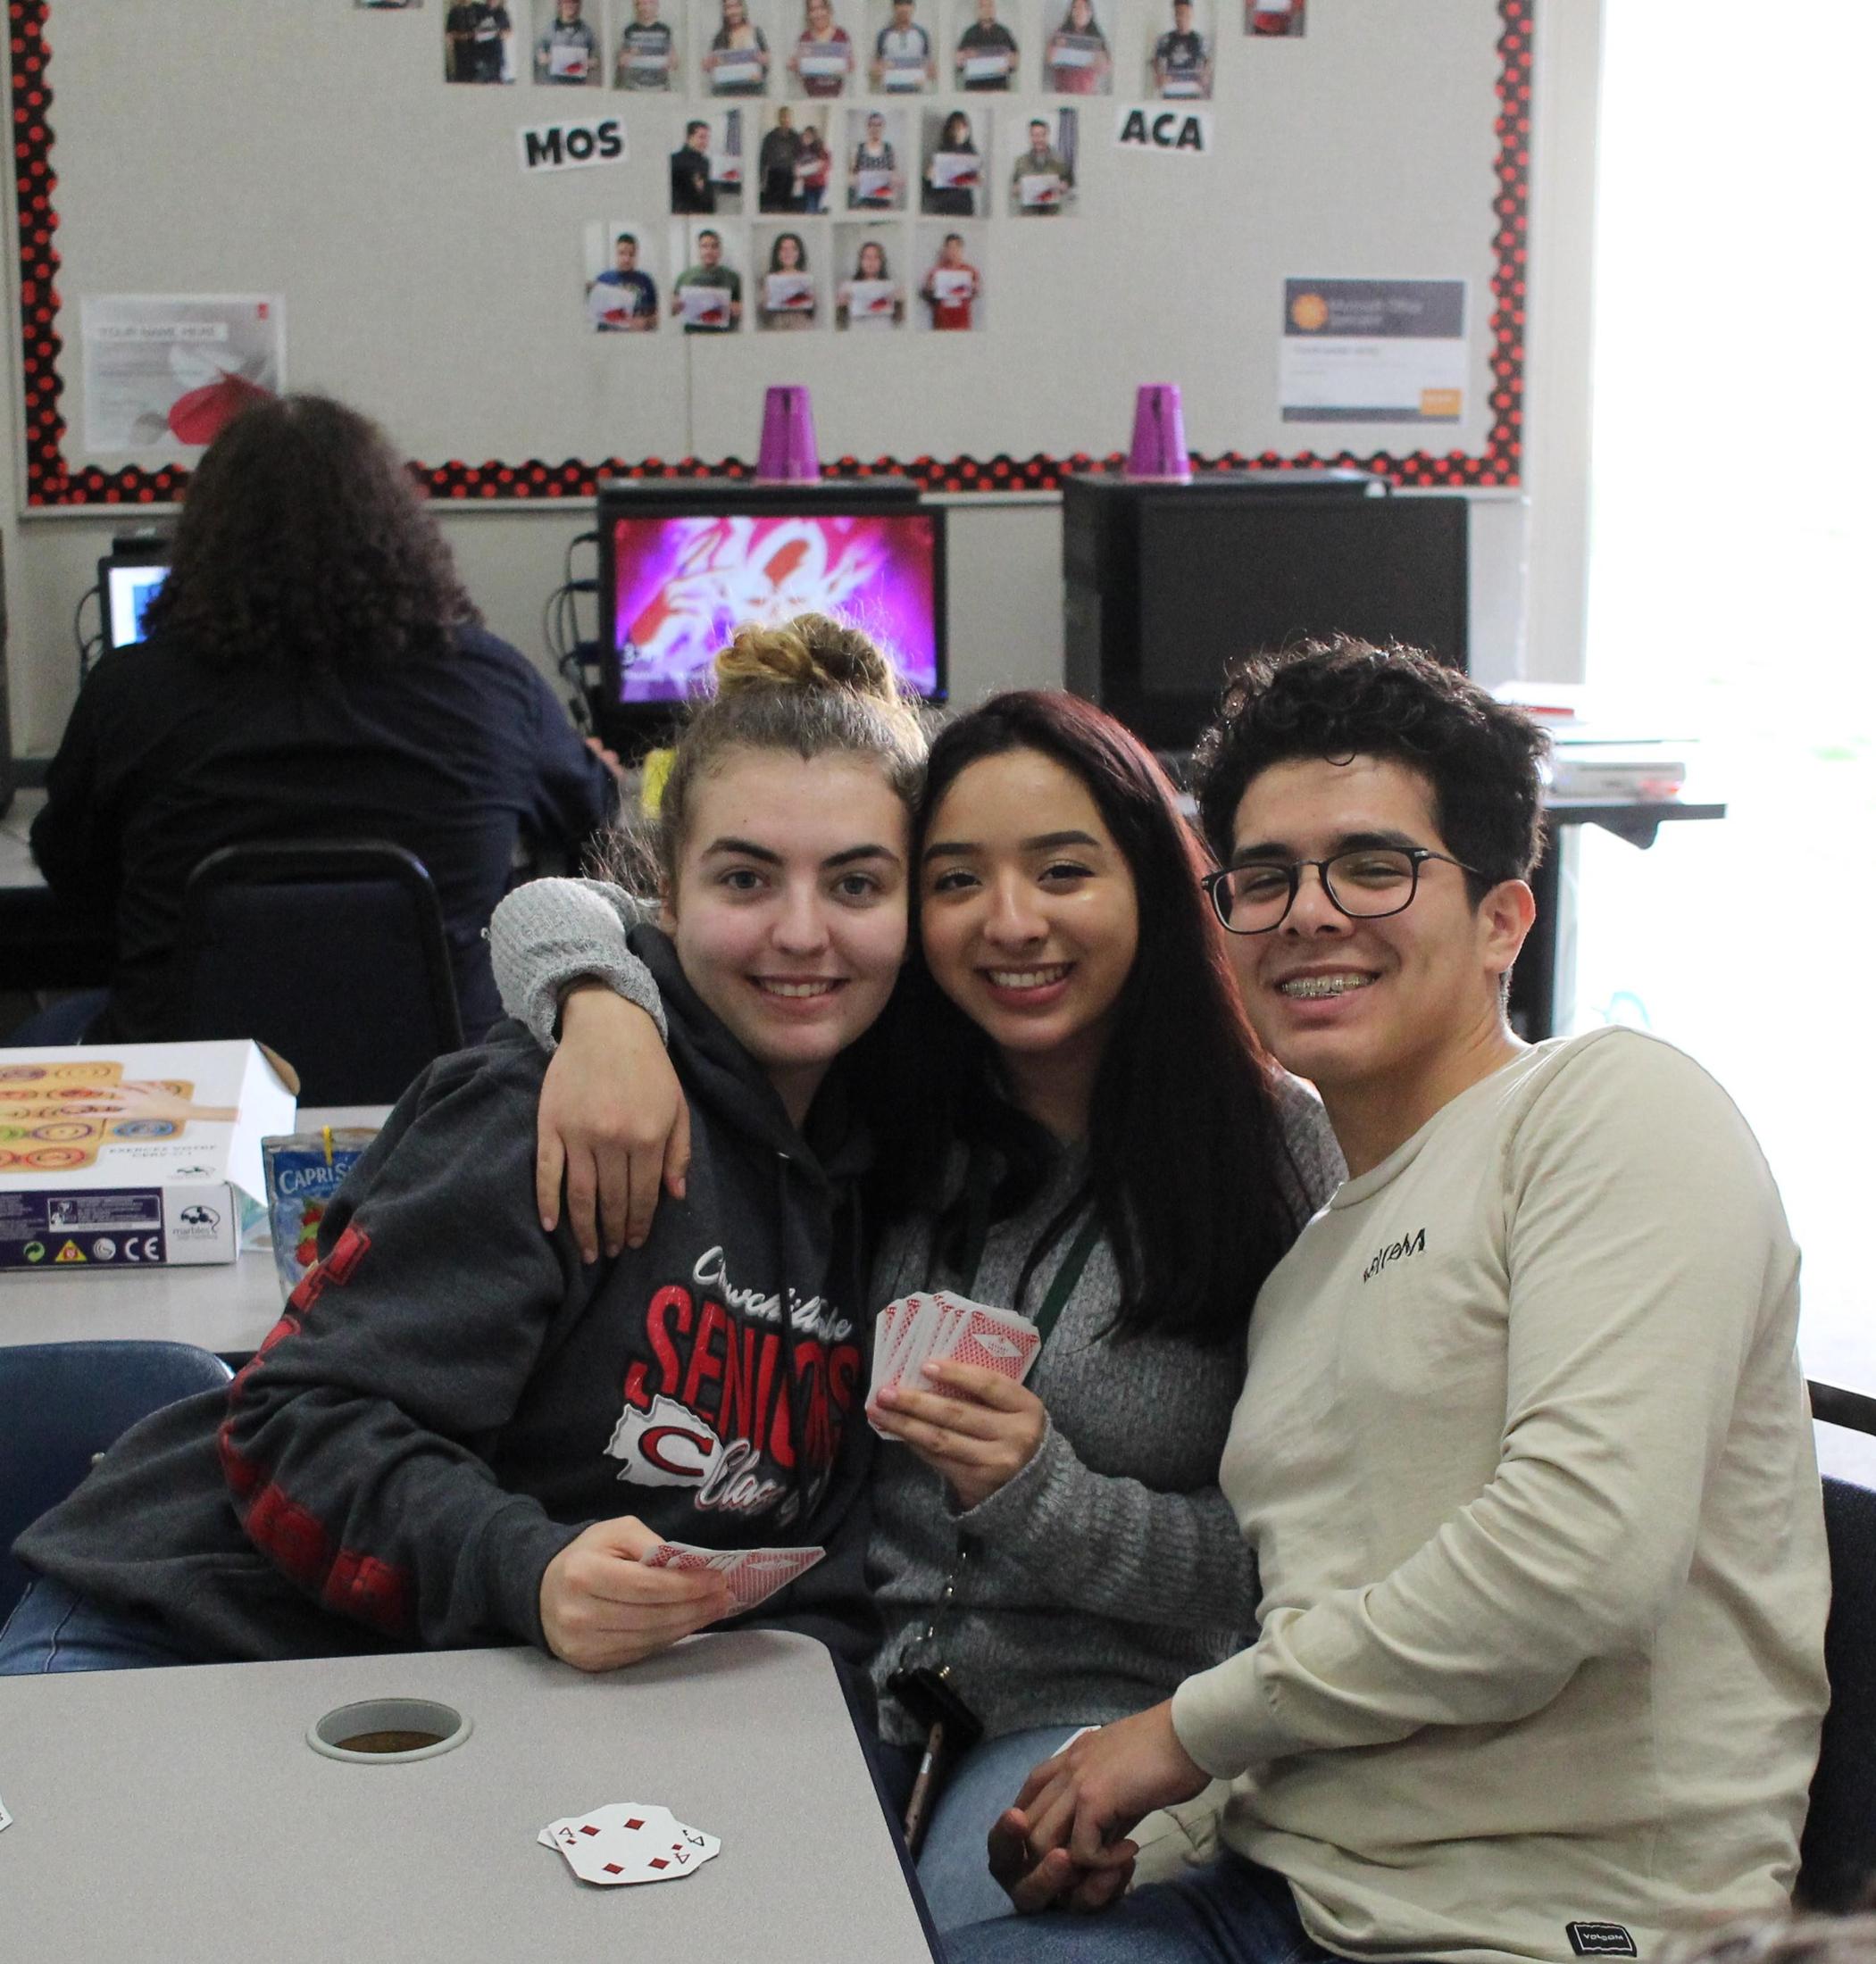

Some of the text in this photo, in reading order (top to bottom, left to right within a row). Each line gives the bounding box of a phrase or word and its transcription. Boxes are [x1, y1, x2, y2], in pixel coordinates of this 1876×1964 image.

[525, 120, 624, 168] MOS
[1119, 109, 1204, 151] ACA
[279, 1166, 333, 1194] CAPRI
[638, 1426, 714, 1478] C
[1583, 1933, 1624, 1941] VOLCOM
